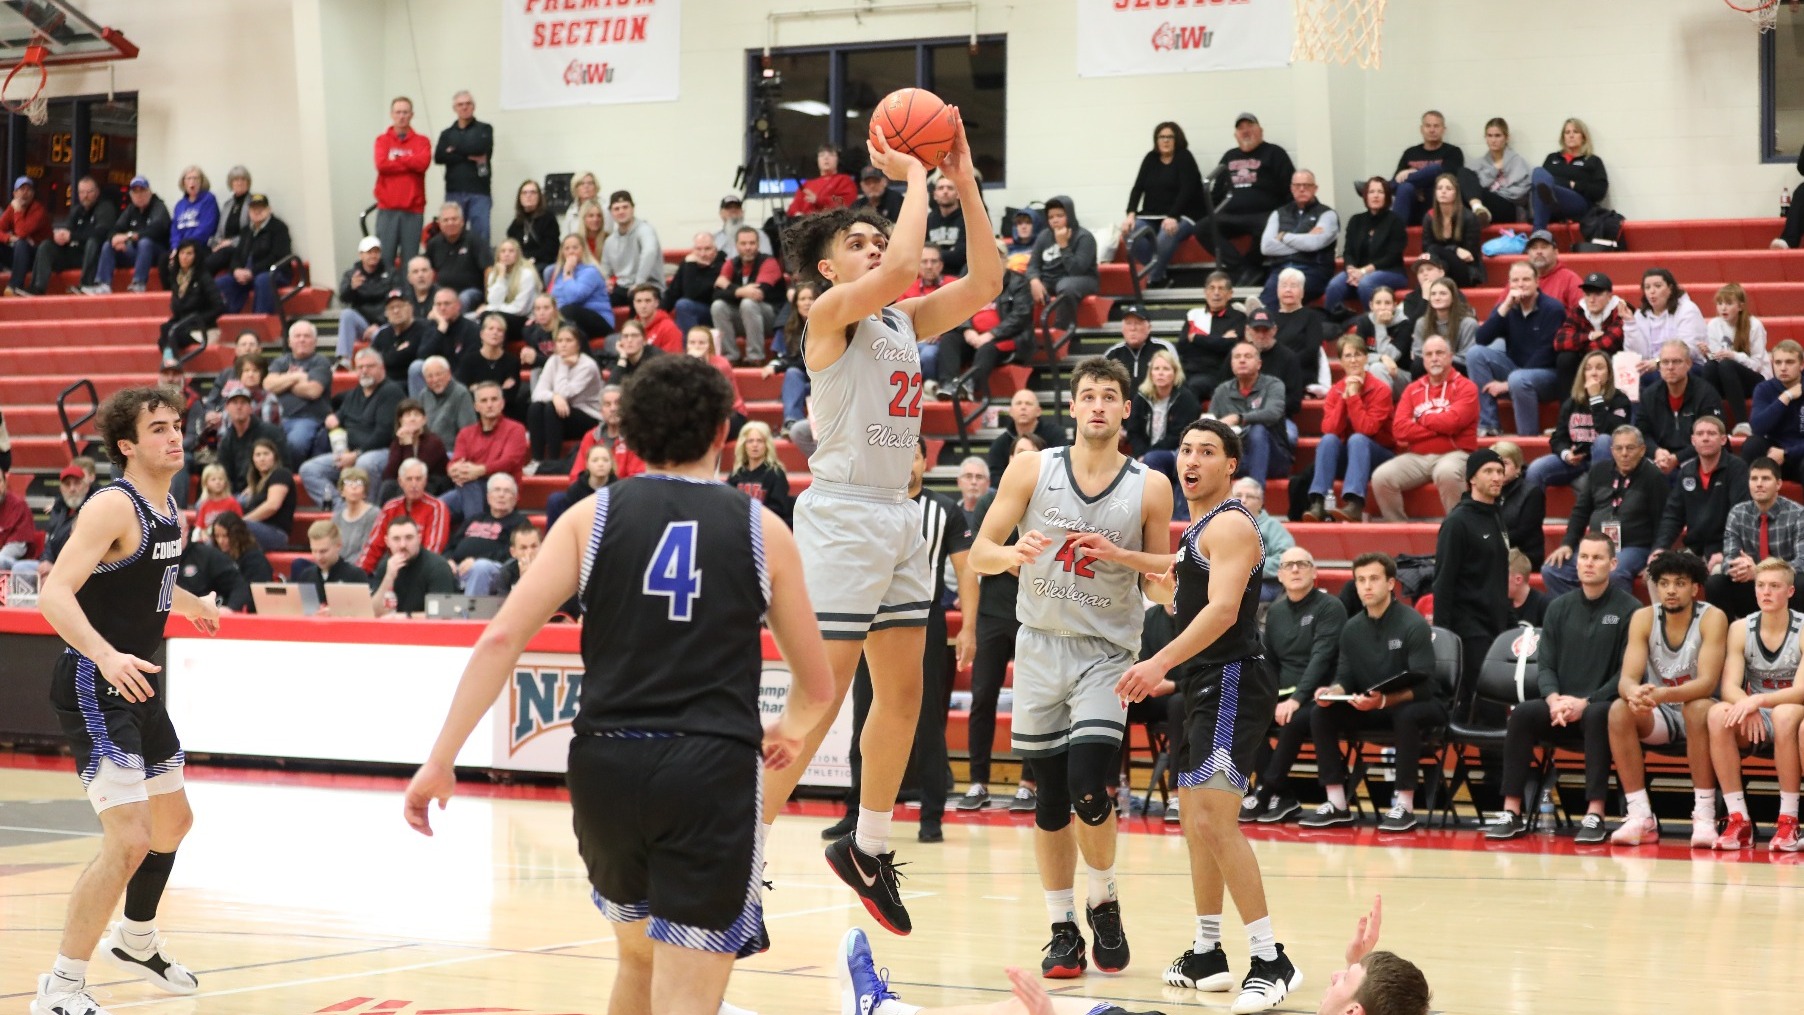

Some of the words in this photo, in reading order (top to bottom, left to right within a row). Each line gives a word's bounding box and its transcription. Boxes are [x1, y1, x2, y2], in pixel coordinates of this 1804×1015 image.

[533, 16, 648, 48] SECTION
[1173, 26, 1214, 50] IWU
[888, 370, 923, 417] 22
[642, 520, 702, 622] 4
[1033, 577, 1111, 608] Wesleyan
